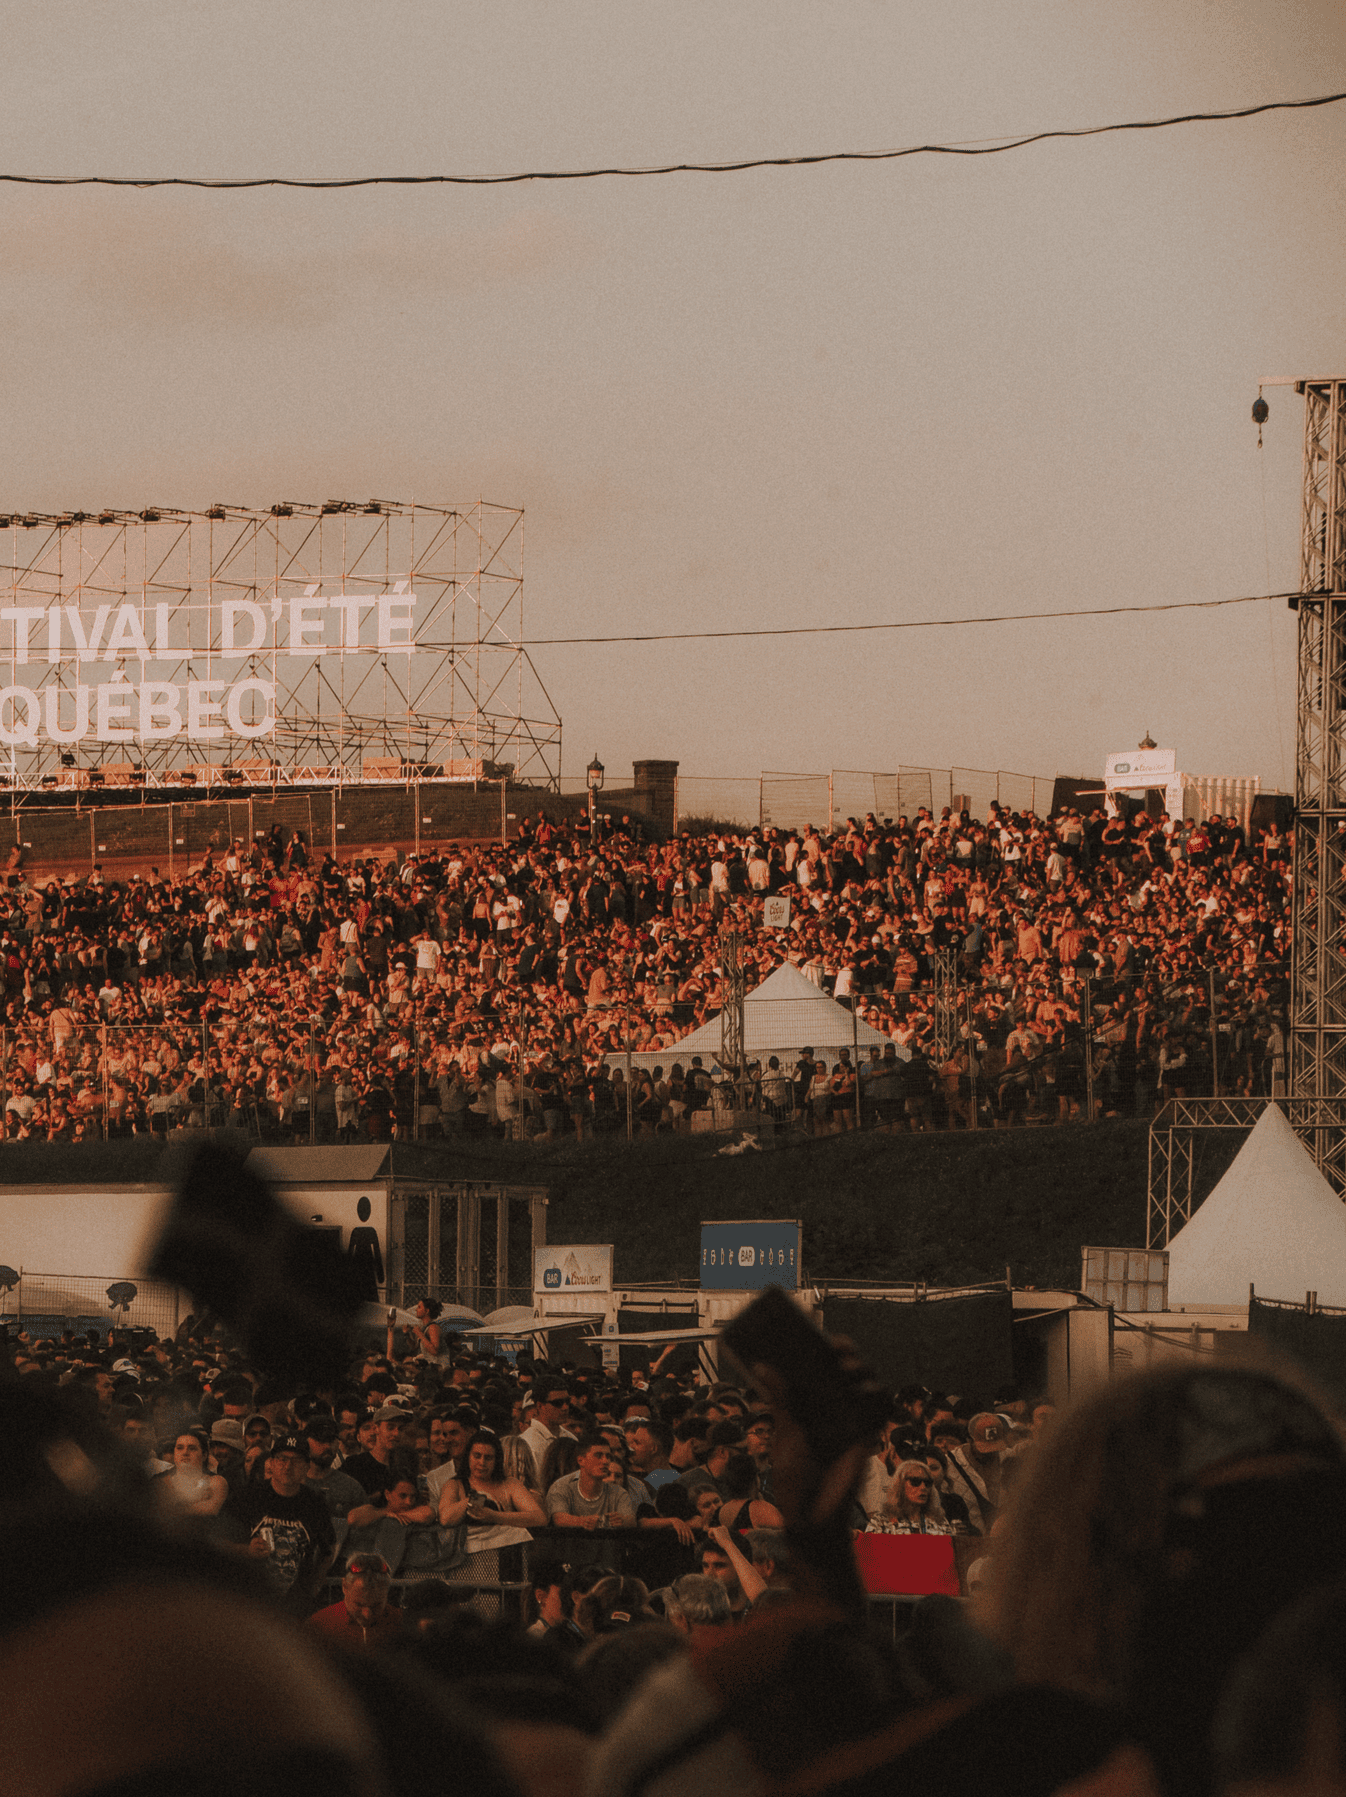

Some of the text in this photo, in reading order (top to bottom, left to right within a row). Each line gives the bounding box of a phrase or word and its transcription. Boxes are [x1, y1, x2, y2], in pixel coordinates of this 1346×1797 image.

[221, 580, 417, 659] D’ÉTÉ
[740, 1249, 753, 1263] BAR
[546, 1273, 559, 1284] BAR
